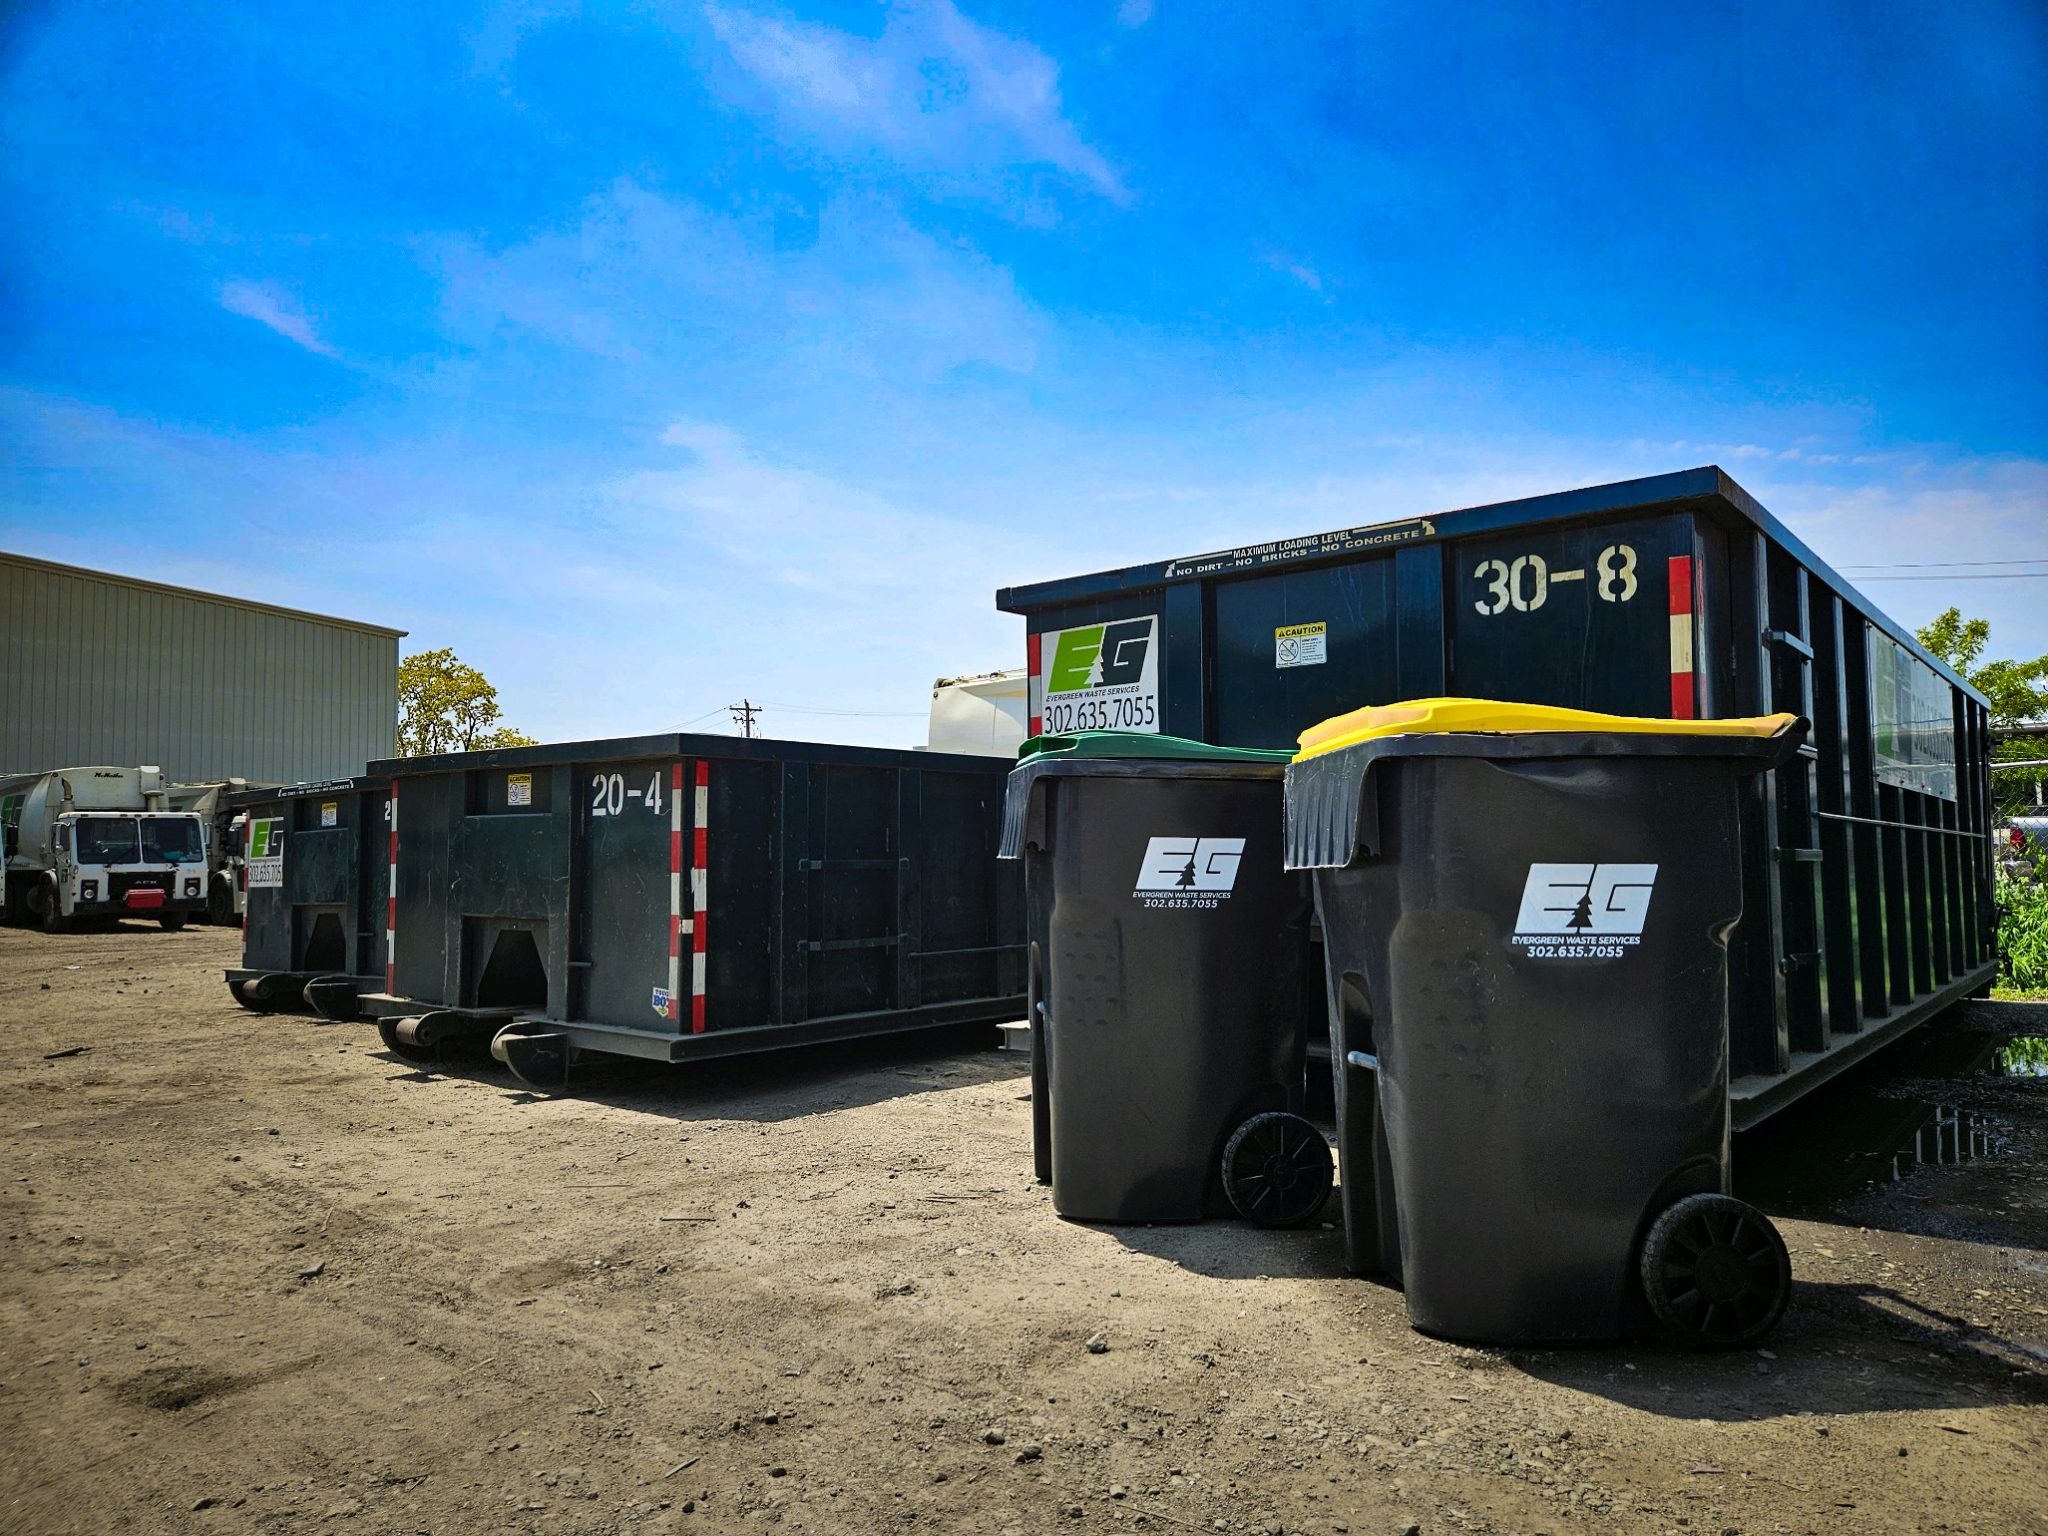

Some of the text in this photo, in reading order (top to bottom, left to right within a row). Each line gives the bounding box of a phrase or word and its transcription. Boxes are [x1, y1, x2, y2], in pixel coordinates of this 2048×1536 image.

[1176, 568, 1192, 576] NO
[1197, 562, 1224, 572] DIRT
[1236, 558, 1252, 566] NO
[1262, 549, 1308, 562] BRICKS
[1322, 544, 1340, 552] NO
[1345, 530, 1420, 548] CONCRETE
[1233, 531, 1351, 559] MAXIMUM LOADING LEVEL
[1286, 625, 1323, 636] CAUTION
[1048, 619, 1153, 693] EG
[1046, 686, 1140, 702] EVERGREEN WASTE SERVICES
[1045, 695, 1155, 734] 302.635.7055
[592, 772, 662, 816] 20-4
[1136, 837, 1246, 890] EG
[1144, 900, 1218, 908] 302.635.7055
[1514, 863, 1658, 934] EG
[1512, 936, 1640, 944] EVERGREEN WASTE SERVICES
[1526, 946, 1624, 958] 302.635.7055
